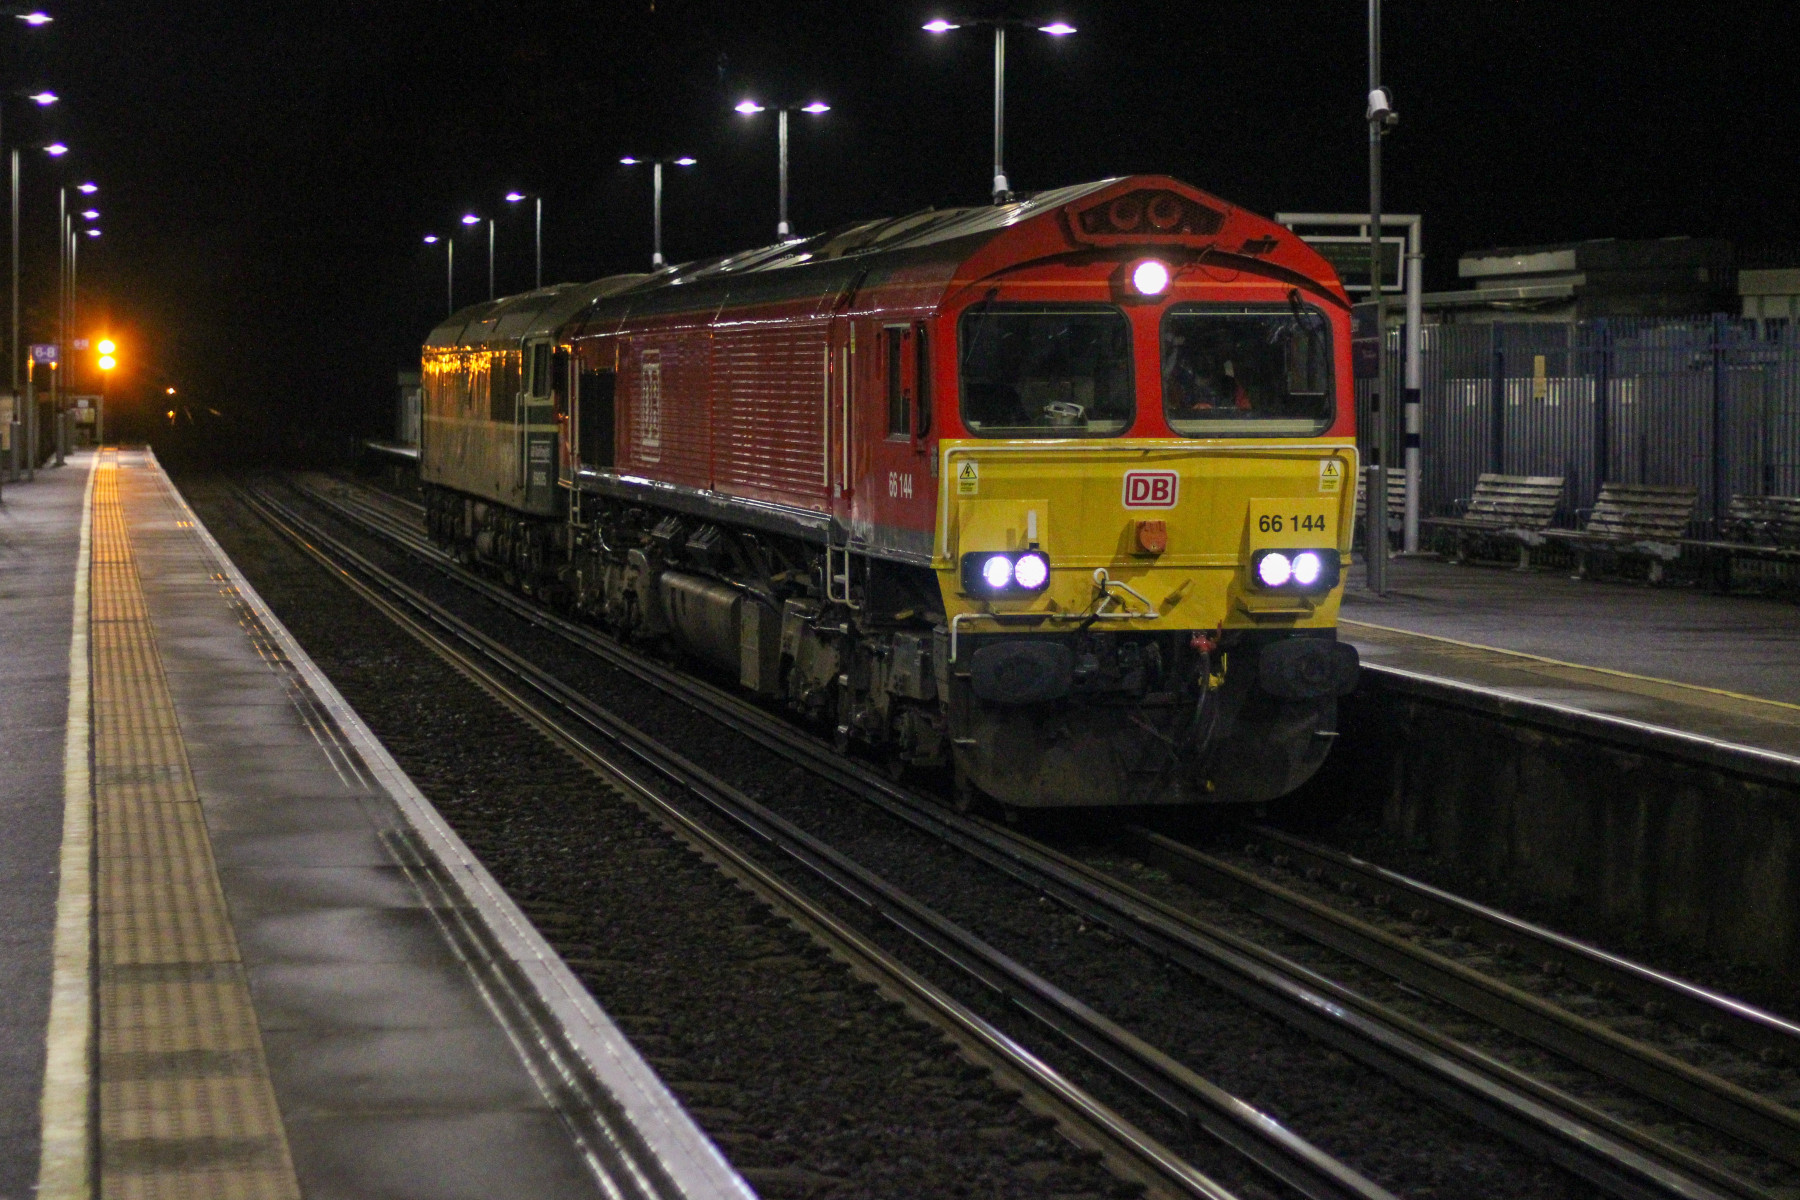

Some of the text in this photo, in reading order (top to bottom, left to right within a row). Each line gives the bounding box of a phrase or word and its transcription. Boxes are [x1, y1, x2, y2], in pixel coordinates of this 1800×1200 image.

[888, 471, 912, 499] 66 144
[1132, 479, 1169, 501] DB
[1259, 514, 1326, 533] 66 144
